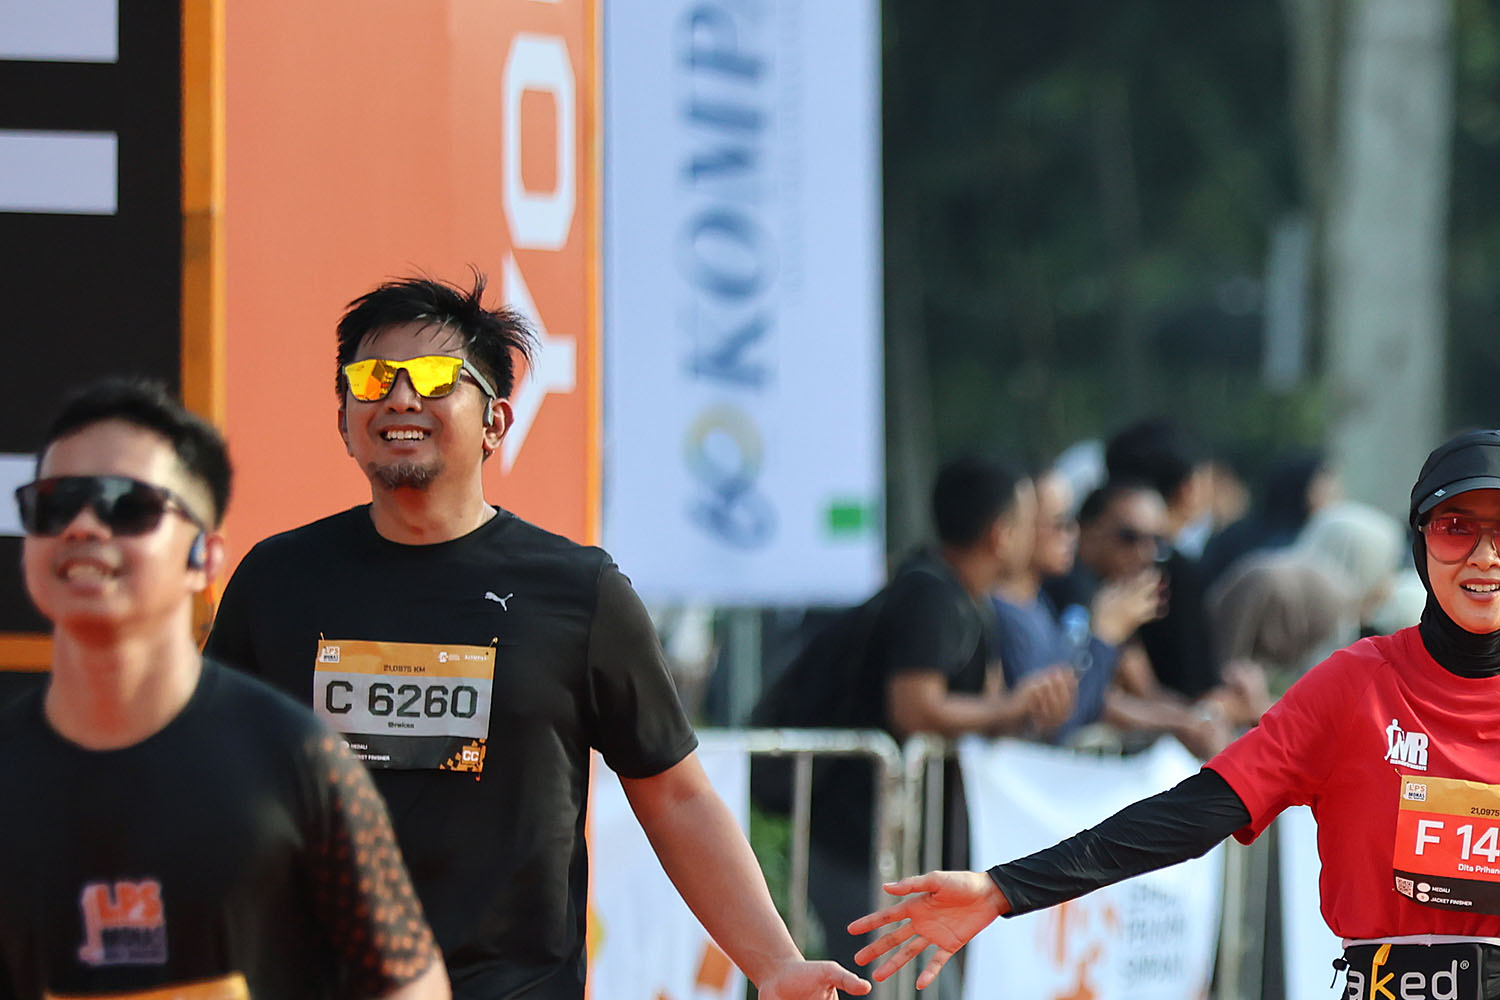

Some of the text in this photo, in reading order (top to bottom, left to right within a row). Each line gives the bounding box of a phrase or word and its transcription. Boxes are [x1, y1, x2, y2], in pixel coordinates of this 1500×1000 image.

[677, 0, 778, 391] KOMP
[503, 0, 577, 474] YO
[326, 680, 479, 719] C 6260
[462, 750, 480, 762] CC
[1408, 784, 1426, 793] LPS
[1470, 806, 1500, 817] 21,0975
[1415, 819, 1445, 856] F
